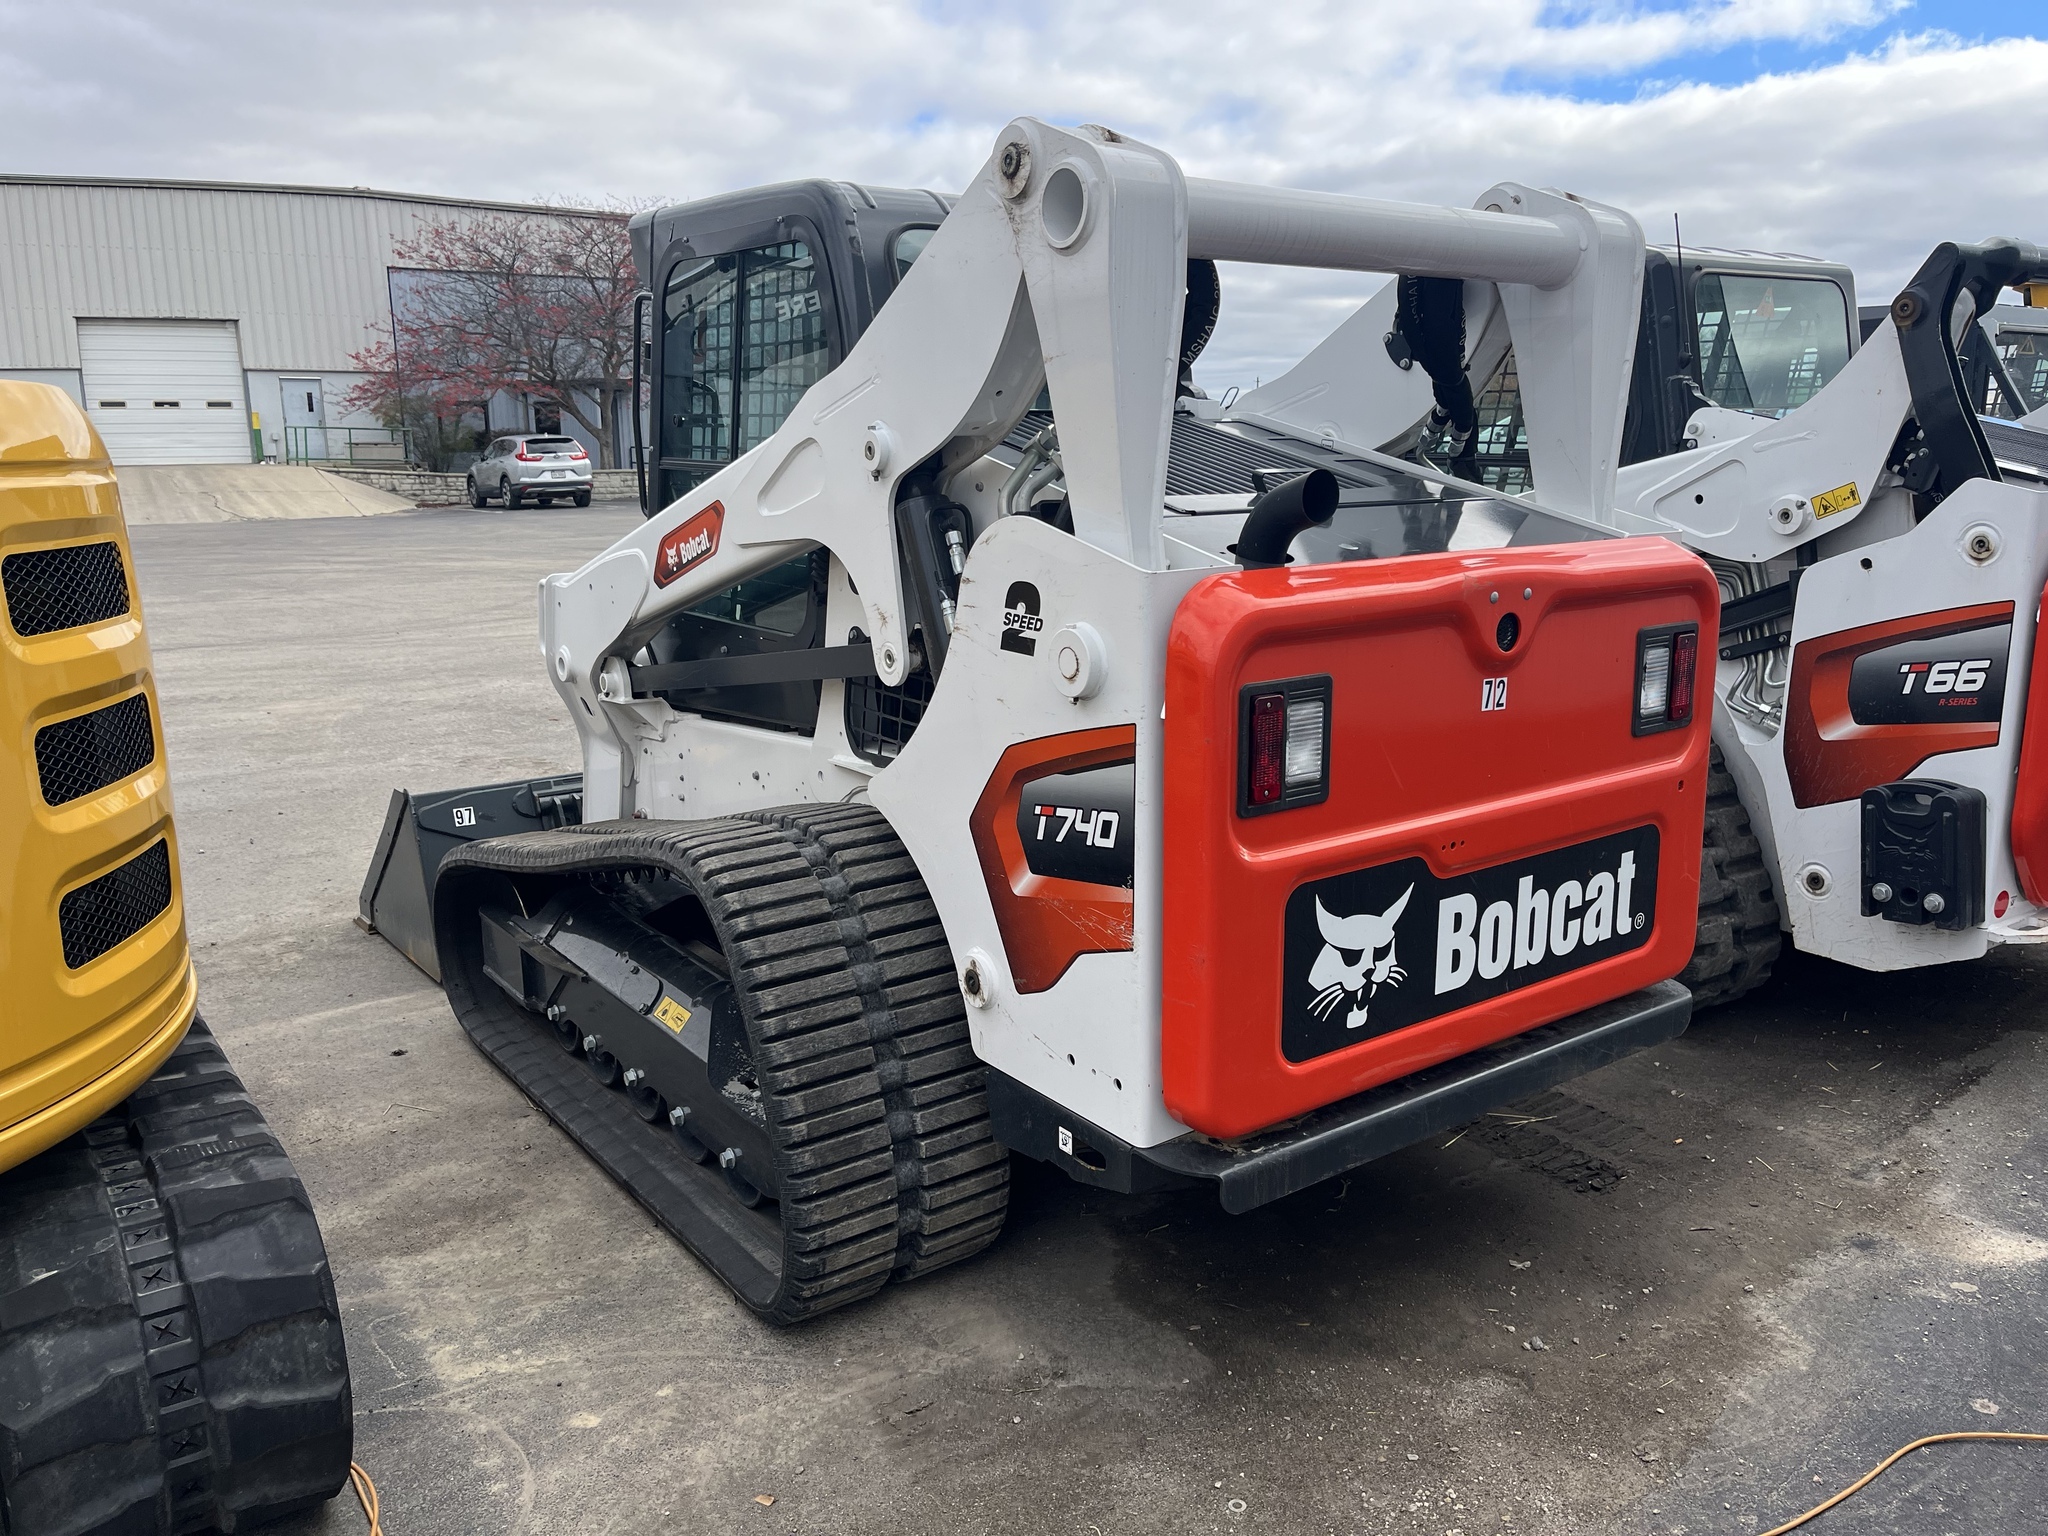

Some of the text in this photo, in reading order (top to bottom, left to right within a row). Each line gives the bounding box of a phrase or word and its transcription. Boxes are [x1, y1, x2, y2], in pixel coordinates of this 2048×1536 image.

[680, 528, 709, 564] Bobcat
[1003, 611, 1043, 632] SPEED
[1900, 660, 1991, 694] T66
[1484, 679, 1506, 709] 72
[1938, 697, 1978, 706] R-SERIES
[455, 808, 472, 825] 97
[1034, 805, 1120, 849] T740
